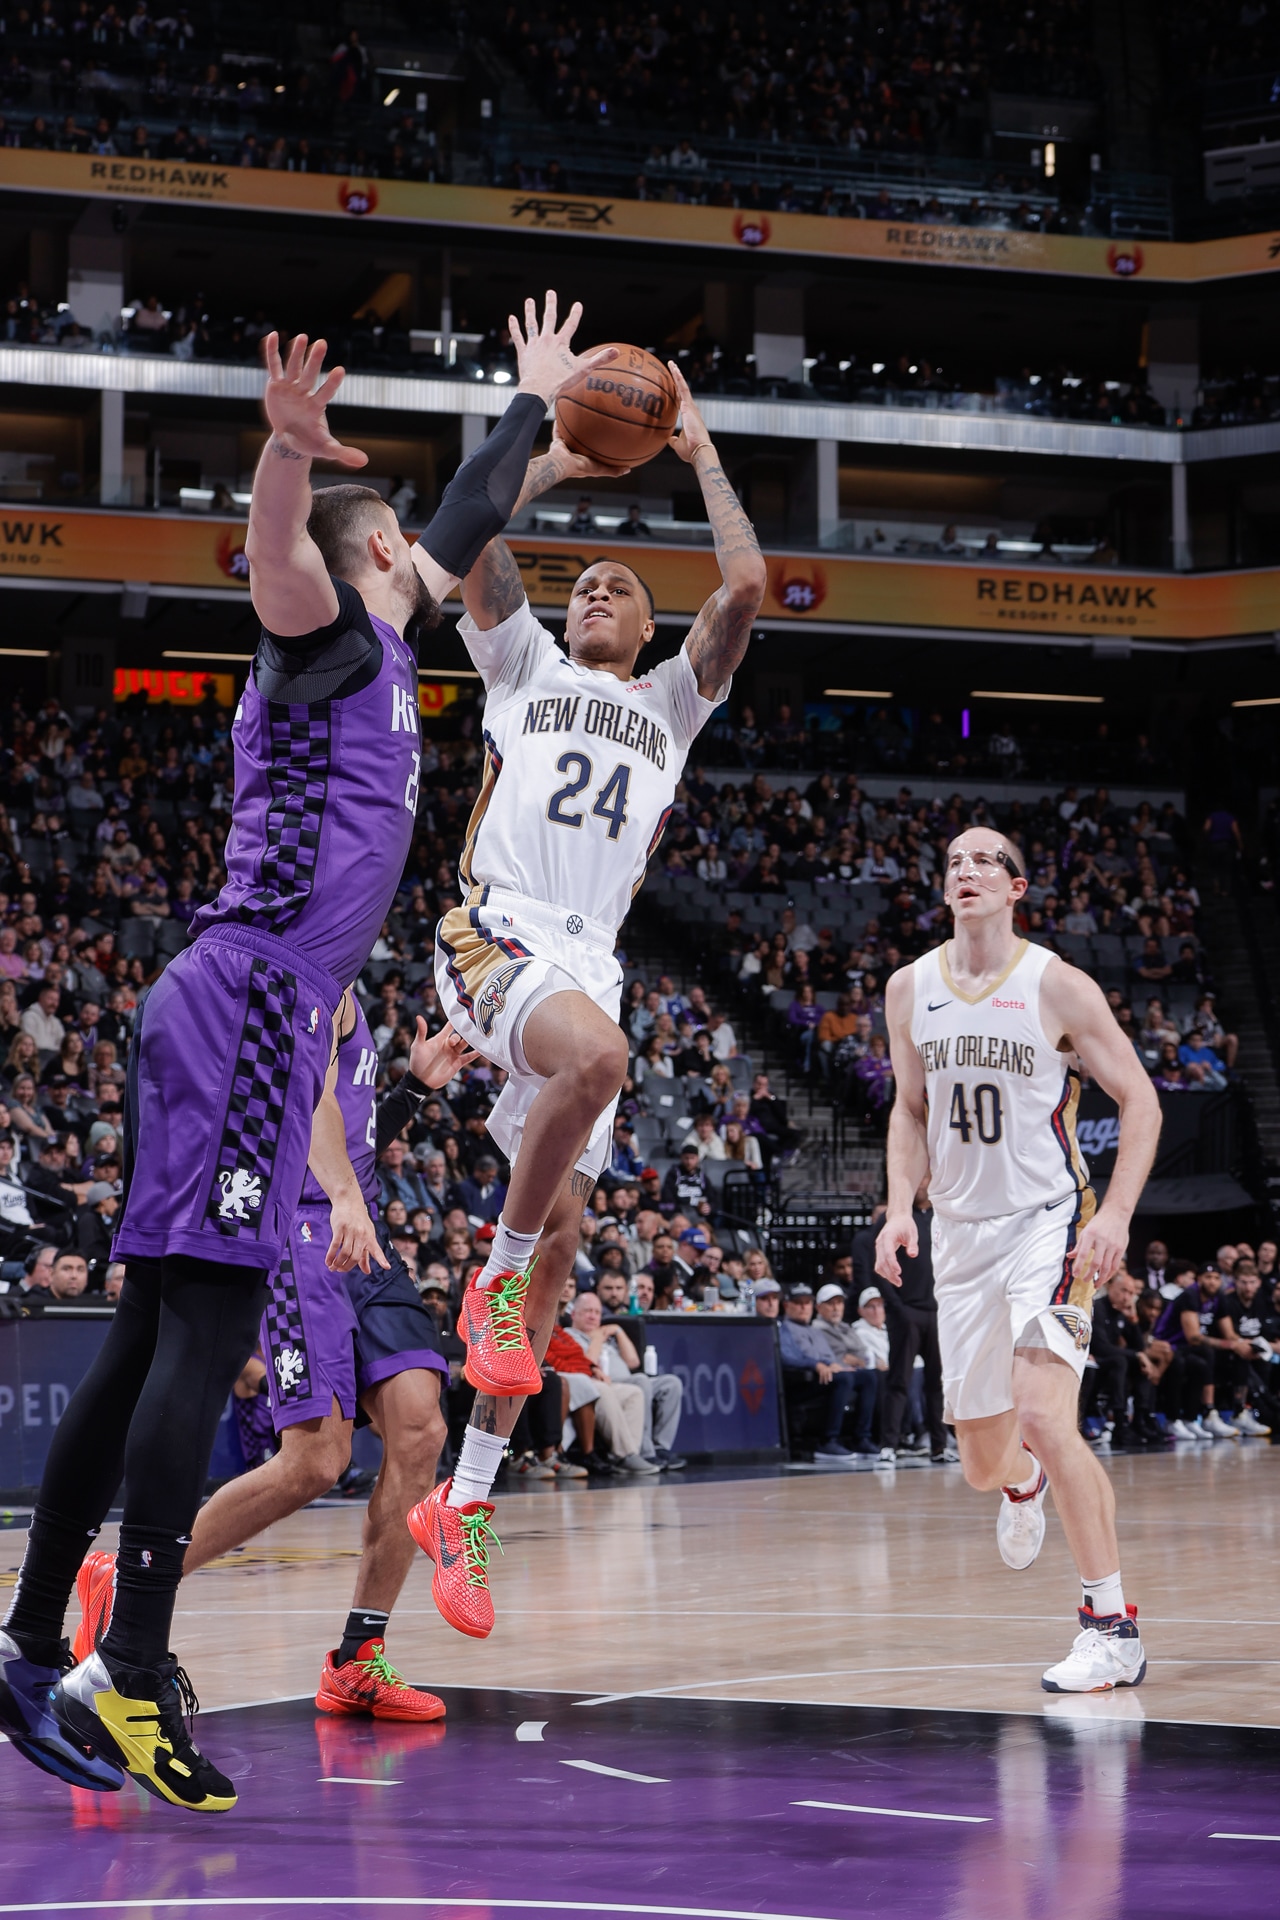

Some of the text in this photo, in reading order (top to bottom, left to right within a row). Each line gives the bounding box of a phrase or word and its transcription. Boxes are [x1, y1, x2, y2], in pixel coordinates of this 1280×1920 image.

[90, 161, 229, 190] REDHAWK
[886, 228, 1009, 252] REDHAWK
[586, 376, 665, 420] Wilson
[976, 578, 1157, 609] REDHAWK
[522, 696, 667, 772] NEW ORLEANS
[545, 750, 633, 843] 24
[992, 998, 1025, 1010] ibotta
[955, 1035, 1035, 1077] ORLEANS
[949, 1083, 1004, 1145] 40
[659, 1363, 737, 1416] RCO
